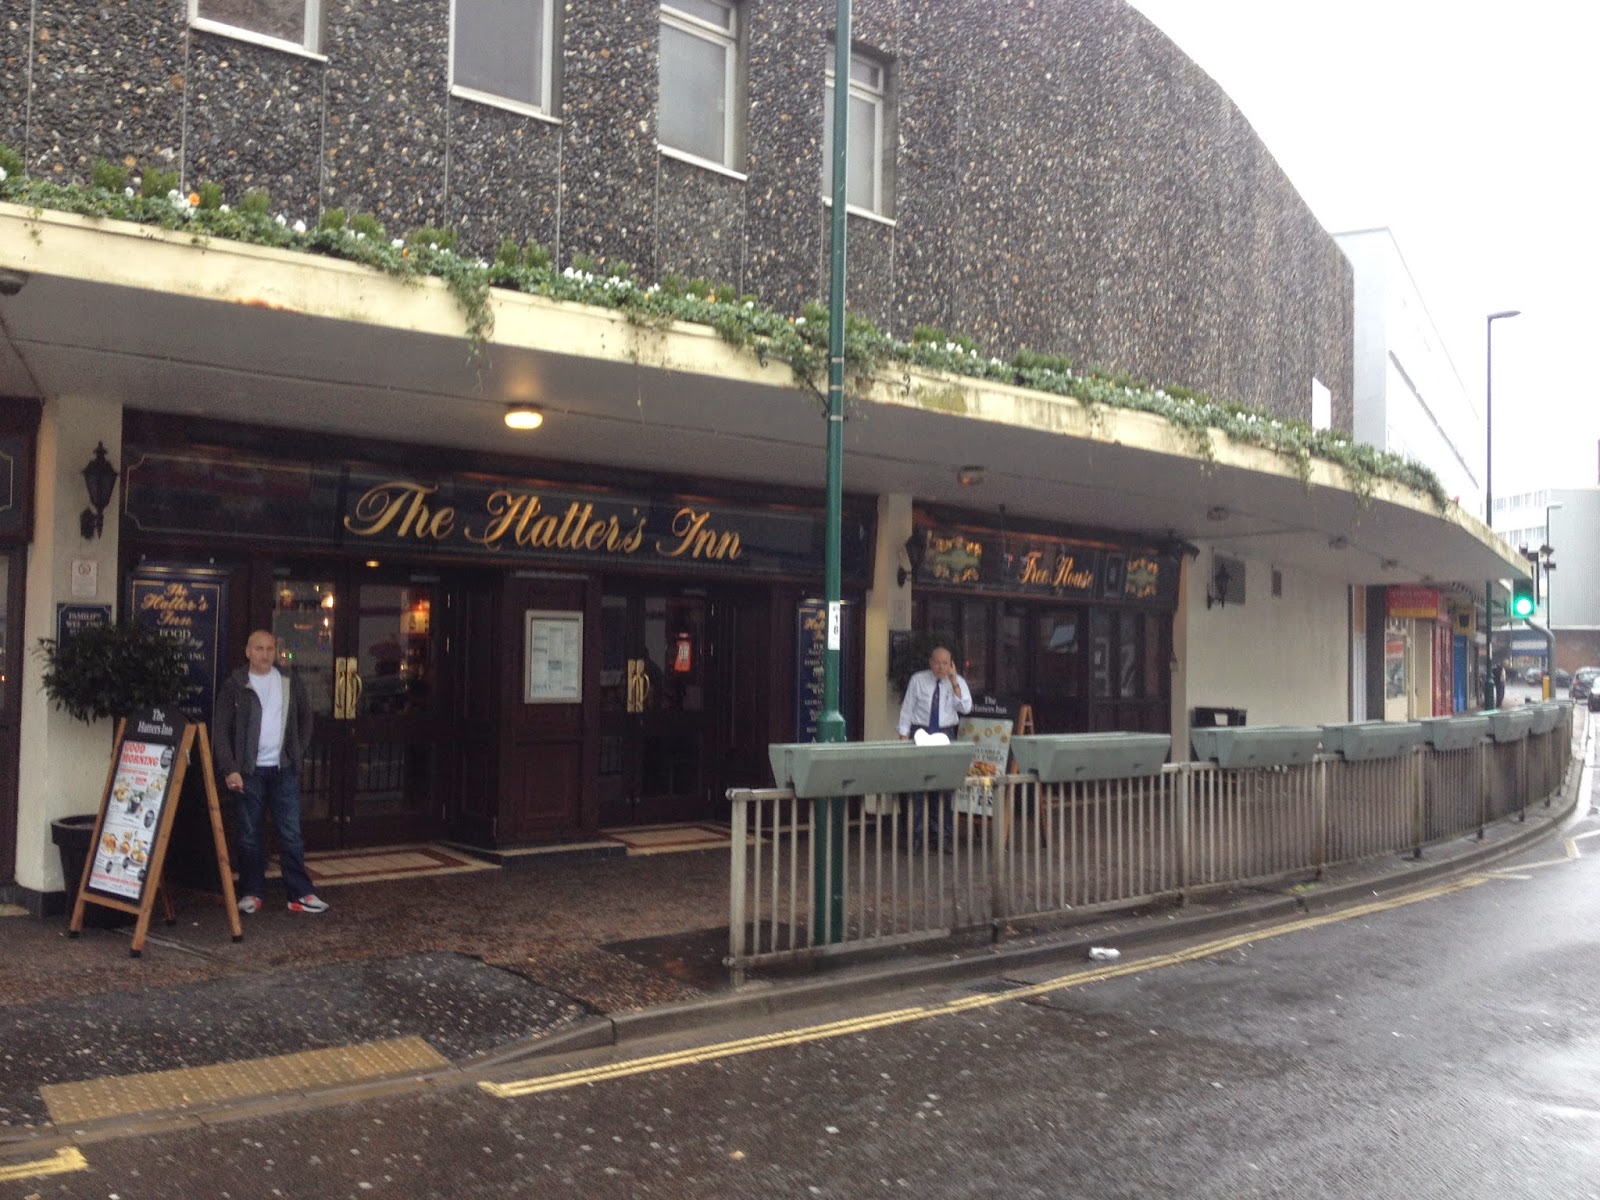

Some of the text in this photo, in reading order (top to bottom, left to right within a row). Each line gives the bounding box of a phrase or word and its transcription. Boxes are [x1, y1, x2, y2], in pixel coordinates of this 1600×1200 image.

[343, 480, 742, 561] The Hatter's Inn
[1049, 553, 1095, 590] House
[164, 582, 188, 597] The
[140, 592, 209, 613] Hatter's
[156, 609, 192, 626] Inn
[152, 708, 166, 722] The
[124, 742, 146, 754] GOOD
[121, 753, 159, 767] MORNING
